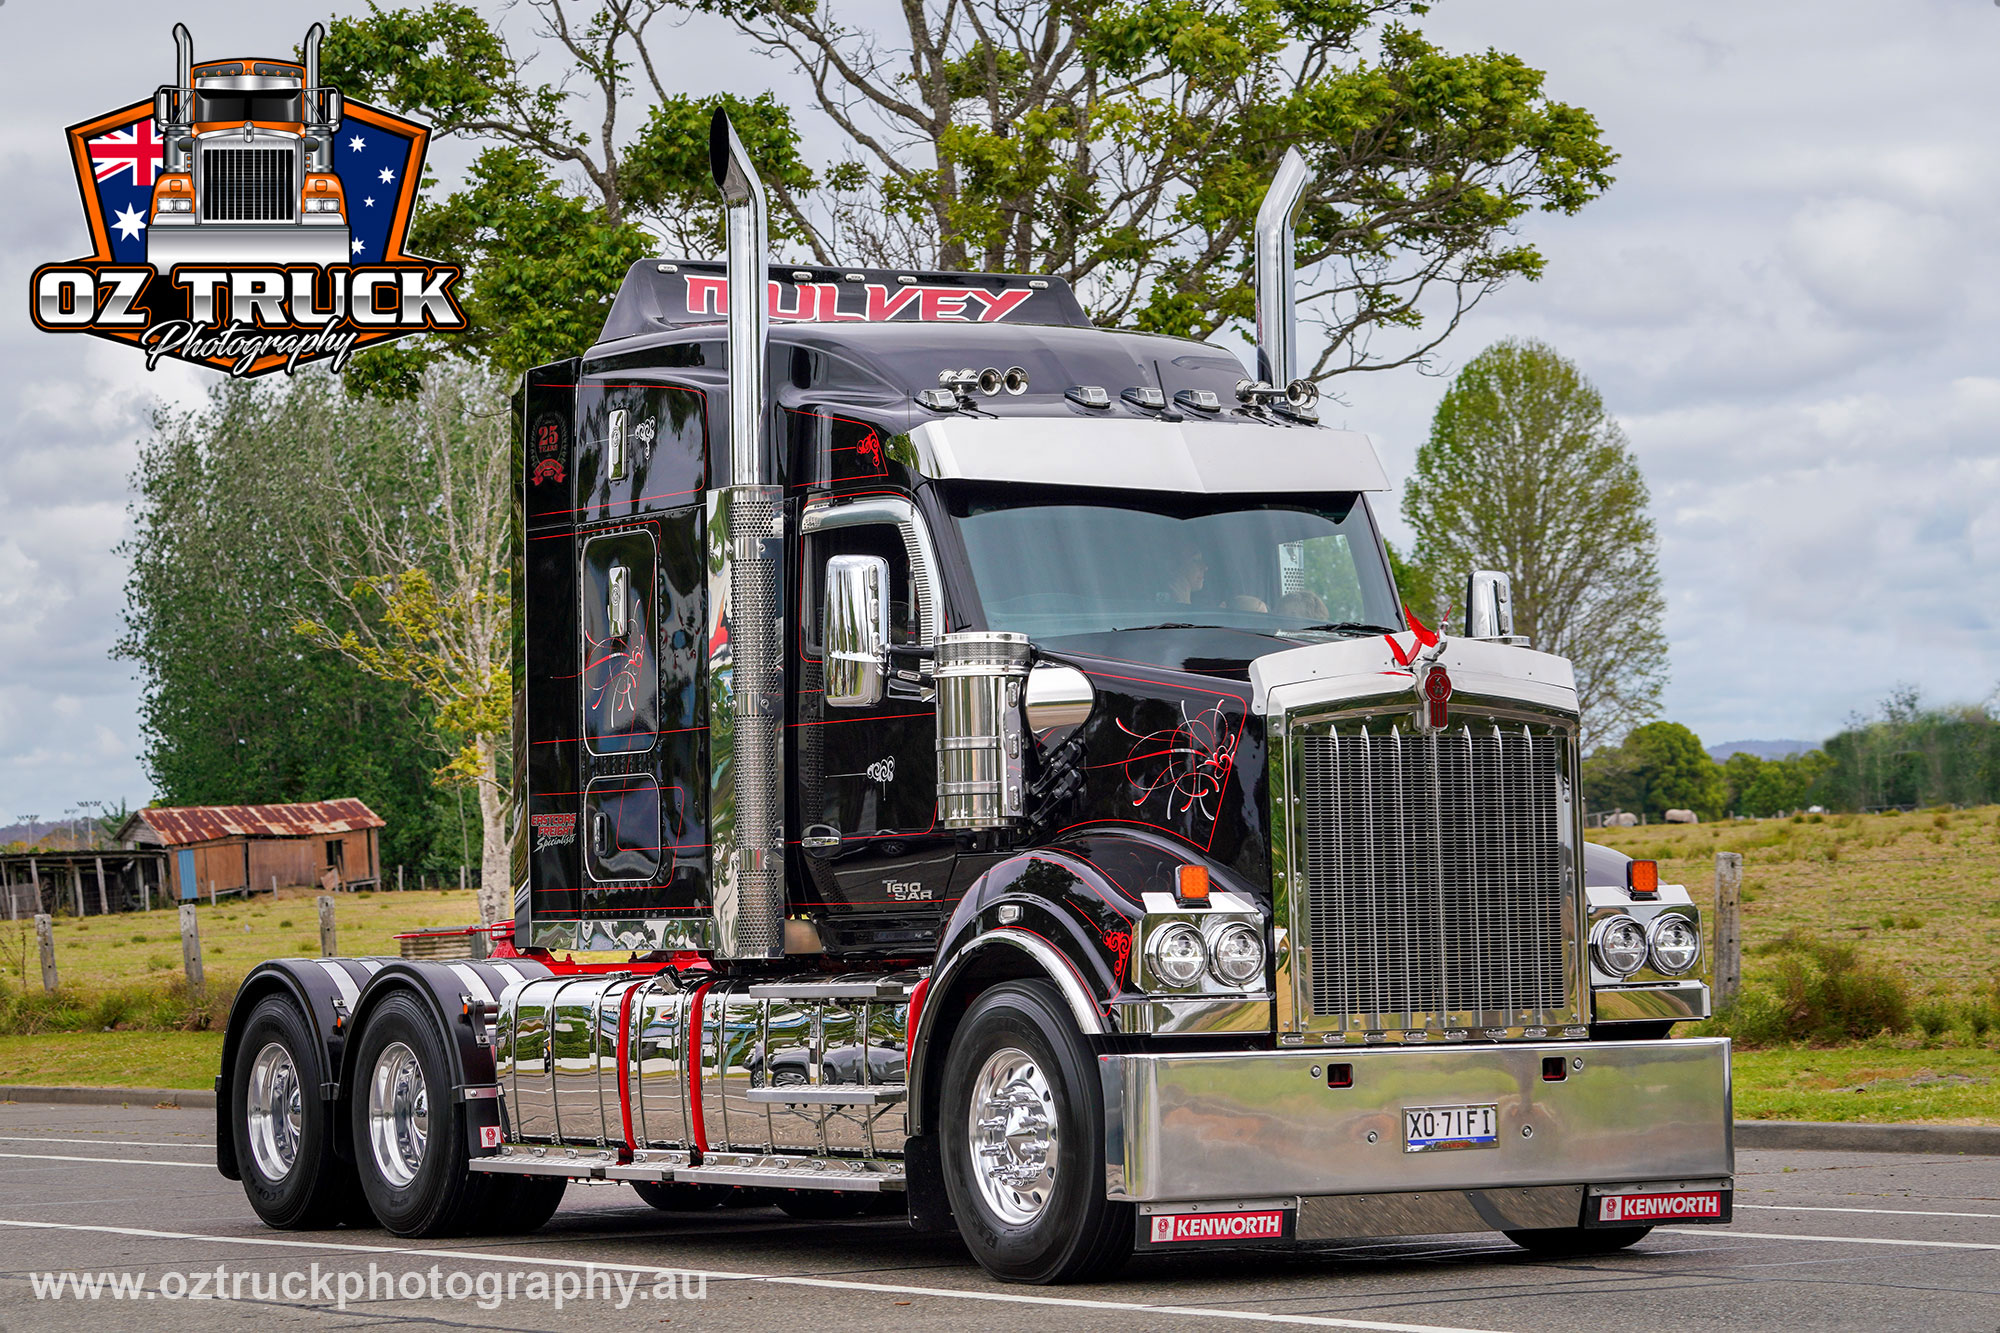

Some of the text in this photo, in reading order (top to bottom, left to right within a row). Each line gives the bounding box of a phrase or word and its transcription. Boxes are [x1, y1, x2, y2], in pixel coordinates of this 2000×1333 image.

[538, 425, 559, 446] 25
[538, 825, 575, 838] FREIGHT
[882, 880, 921, 893] T610
[895, 889, 933, 901] SAR
[1624, 1196, 1717, 1215] KENWORTH
[1176, 1215, 1280, 1237] KENWORTH
